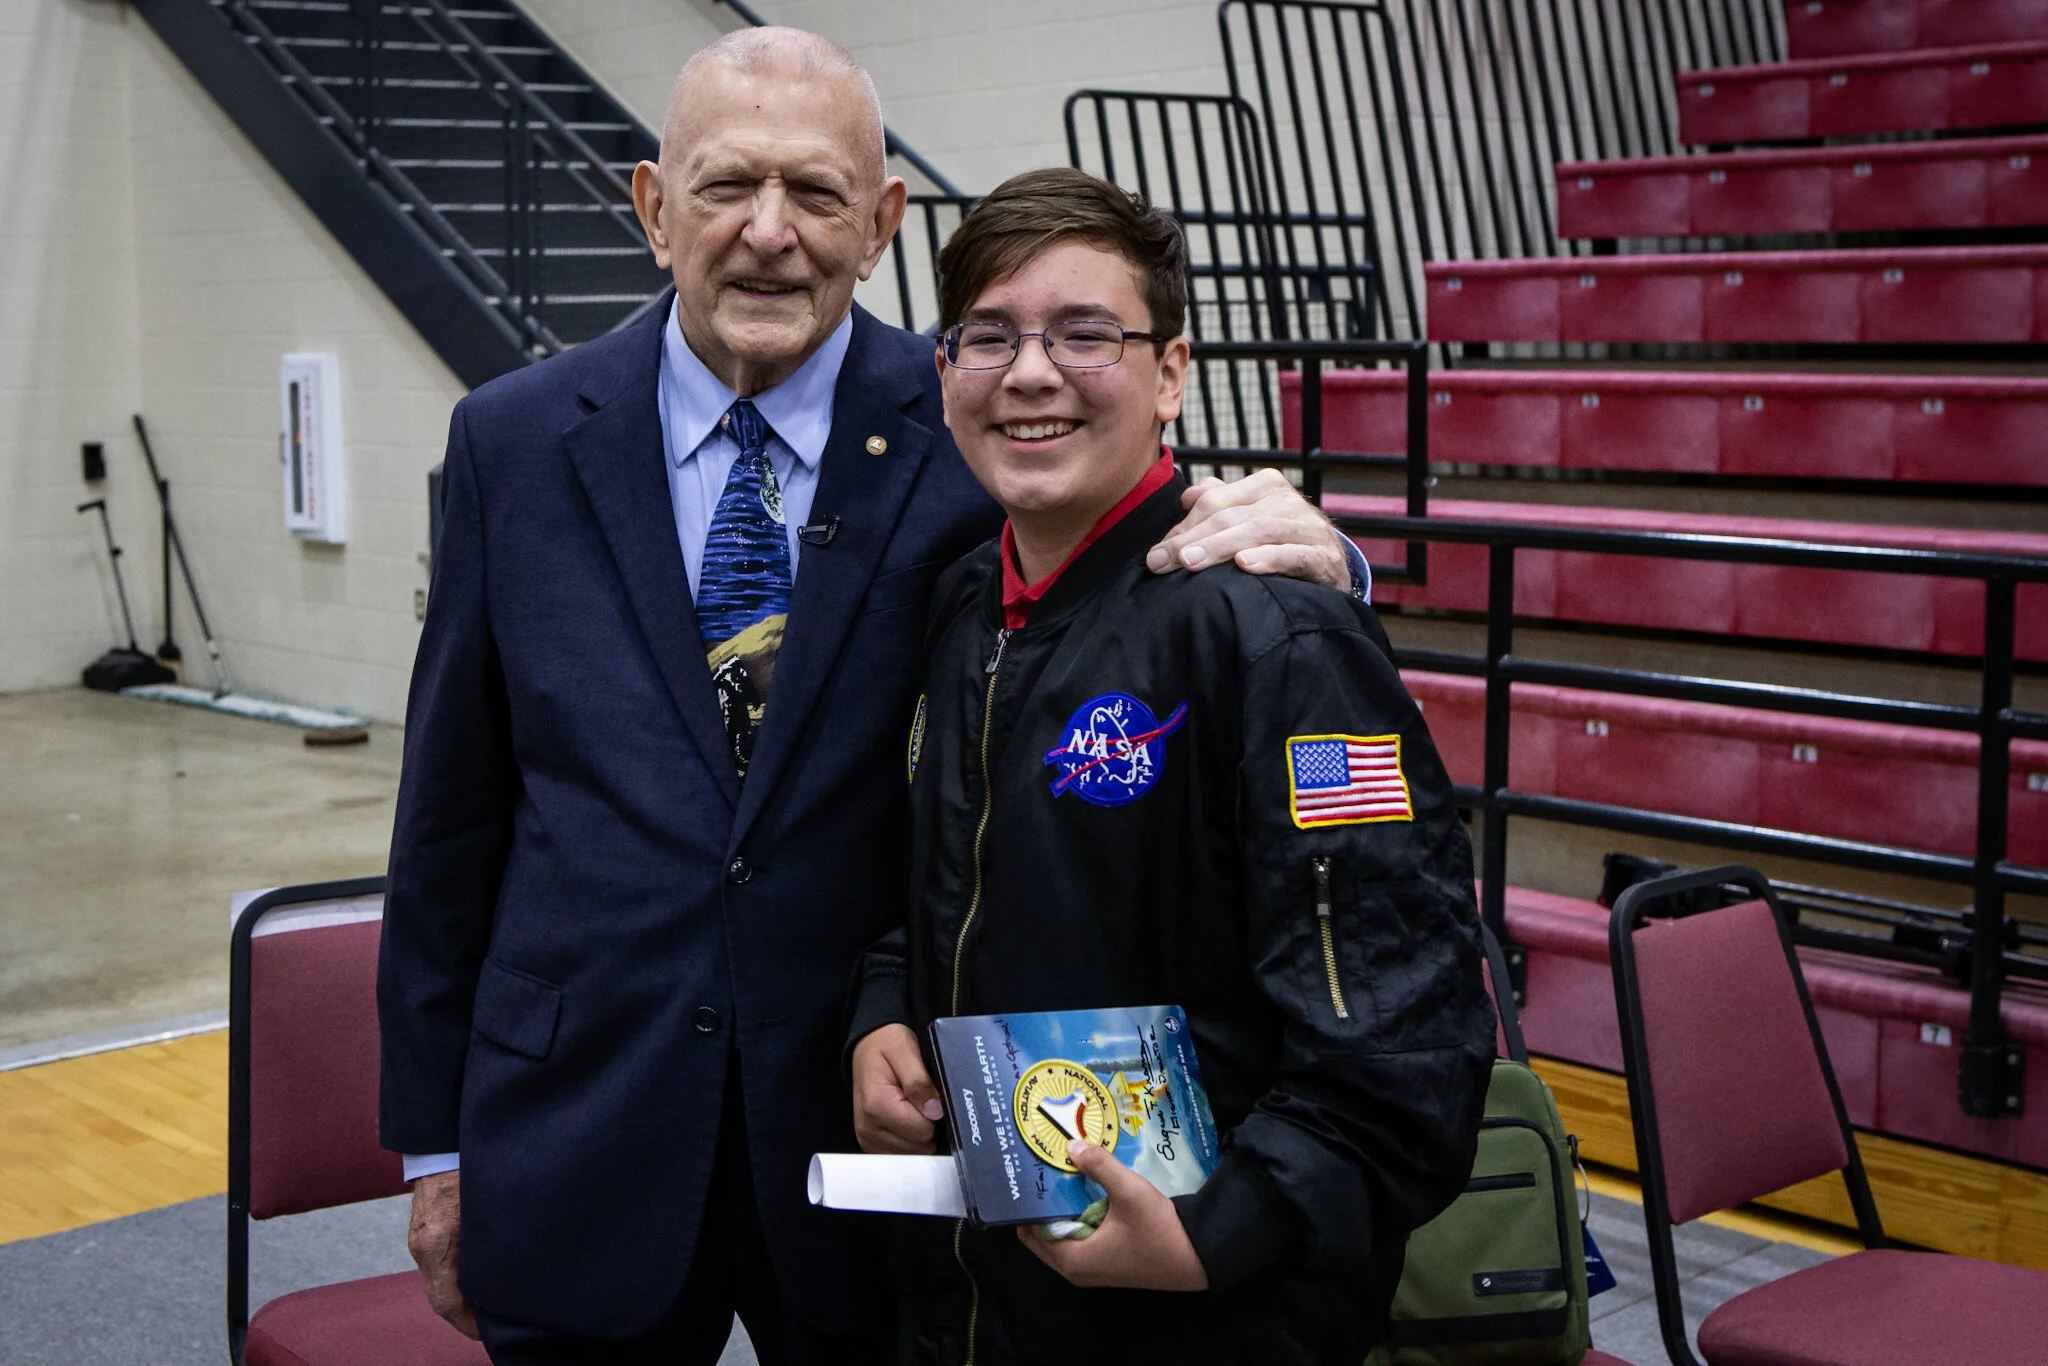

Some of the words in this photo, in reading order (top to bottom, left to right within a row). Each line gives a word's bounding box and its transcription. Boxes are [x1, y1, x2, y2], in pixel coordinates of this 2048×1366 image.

[1066, 728, 1153, 766] NASA
[974, 1035, 993, 1085] EARTH
[1177, 1043, 1185, 1064] NASA
[989, 1055, 1007, 1110] MISSIONS
[1064, 1068, 1109, 1111] NATIONAL
[1182, 1064, 1191, 1084] WITH
[987, 1087, 1003, 1124] LEFT
[1020, 1075, 1038, 1121] AVIATION
[1187, 1085, 1208, 1147] COLLABORATION
[995, 1125, 1008, 1152] WE
[1004, 1116, 1015, 1146] NASA
[1031, 1134, 1054, 1159] HALL
[1013, 1153, 1022, 1172] THE
[1204, 1148, 1211, 1157] IN
[1002, 1153, 1021, 1200] WHEN
